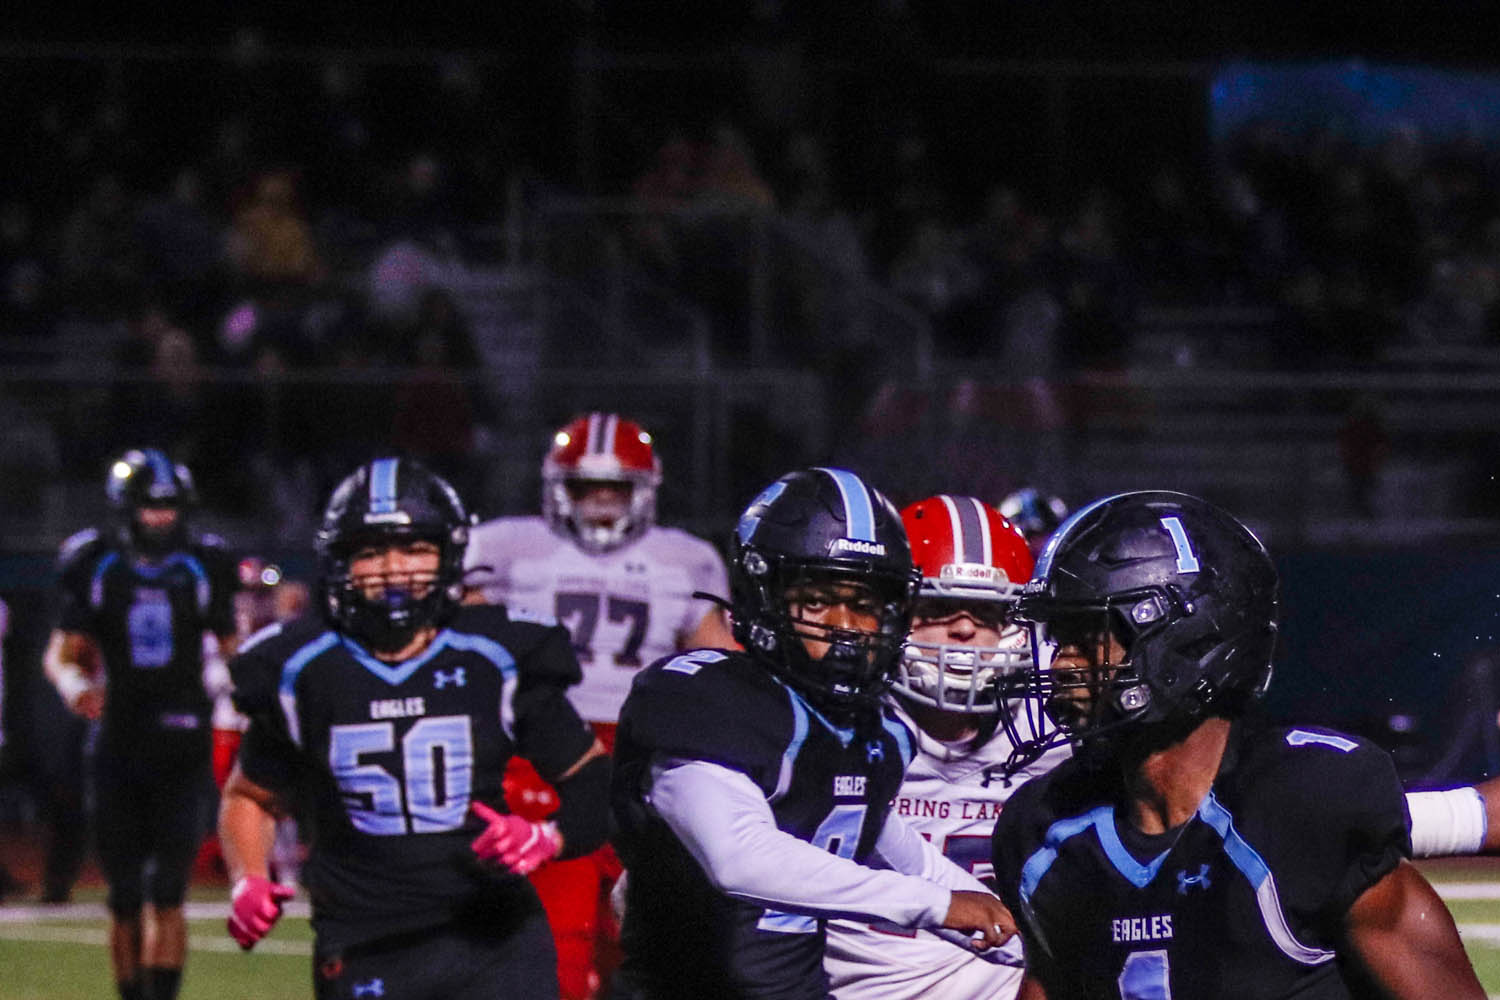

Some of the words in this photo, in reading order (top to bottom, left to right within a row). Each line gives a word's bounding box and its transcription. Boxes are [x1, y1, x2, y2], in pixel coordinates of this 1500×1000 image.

[838, 538, 886, 556] Riddell
[1159, 517, 1200, 574] 1
[956, 567, 991, 578] Rddell
[555, 591, 651, 668] 77
[662, 650, 728, 675] 2
[329, 715, 475, 836] 50
[833, 776, 867, 797] EAGLES
[888, 797, 951, 819] RING
[962, 802, 1004, 820] LAK
[1112, 915, 1173, 942] EAGLES
